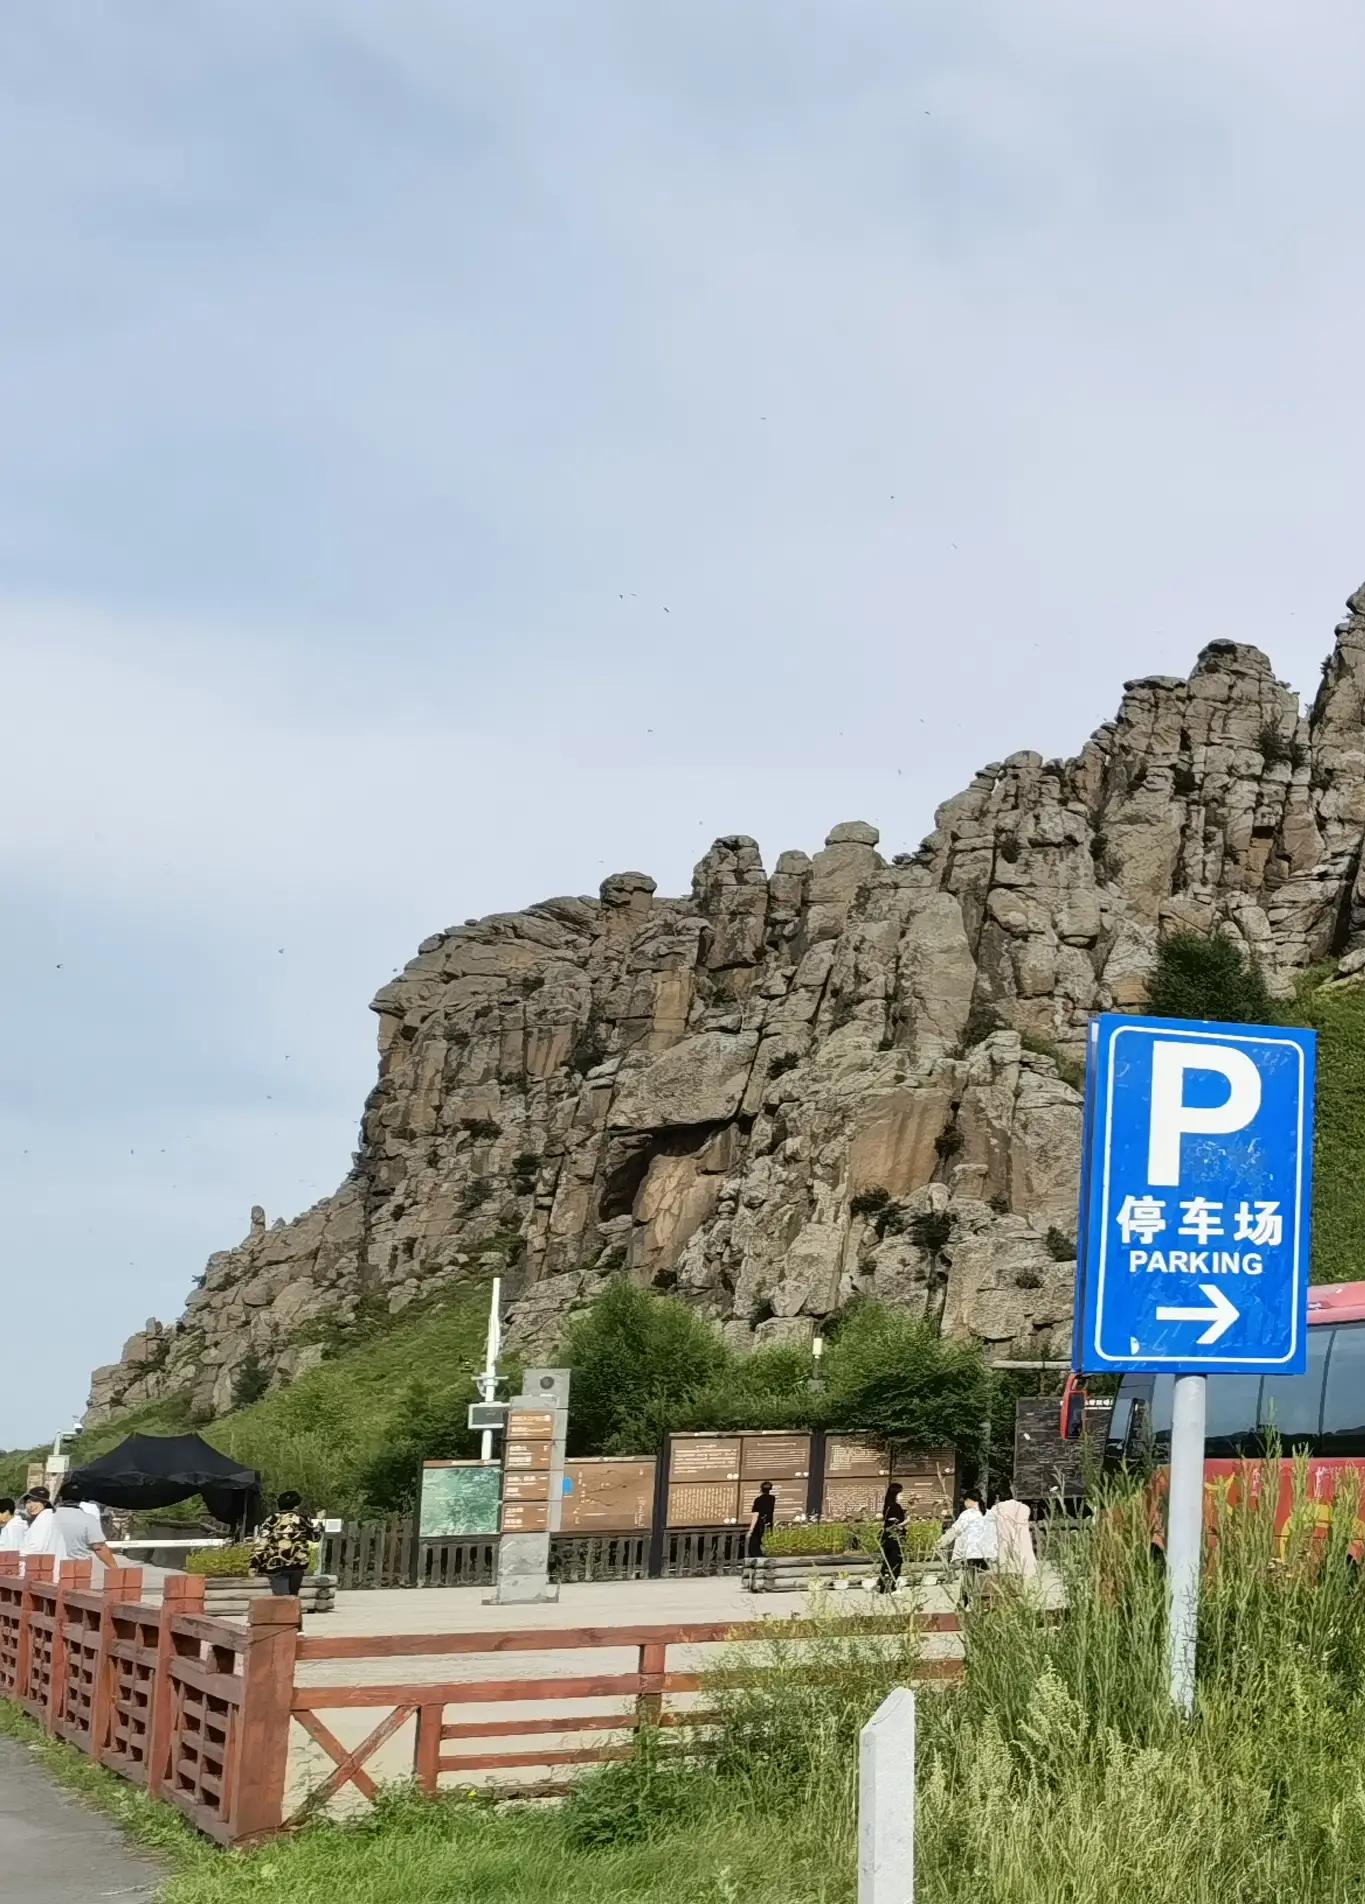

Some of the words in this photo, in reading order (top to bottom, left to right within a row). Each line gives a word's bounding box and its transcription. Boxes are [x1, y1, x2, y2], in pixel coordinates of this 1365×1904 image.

[1147, 1040, 1262, 1186] P
[1116, 1195, 1283, 1246] 停车场
[1129, 1249, 1264, 1275] PARKING
